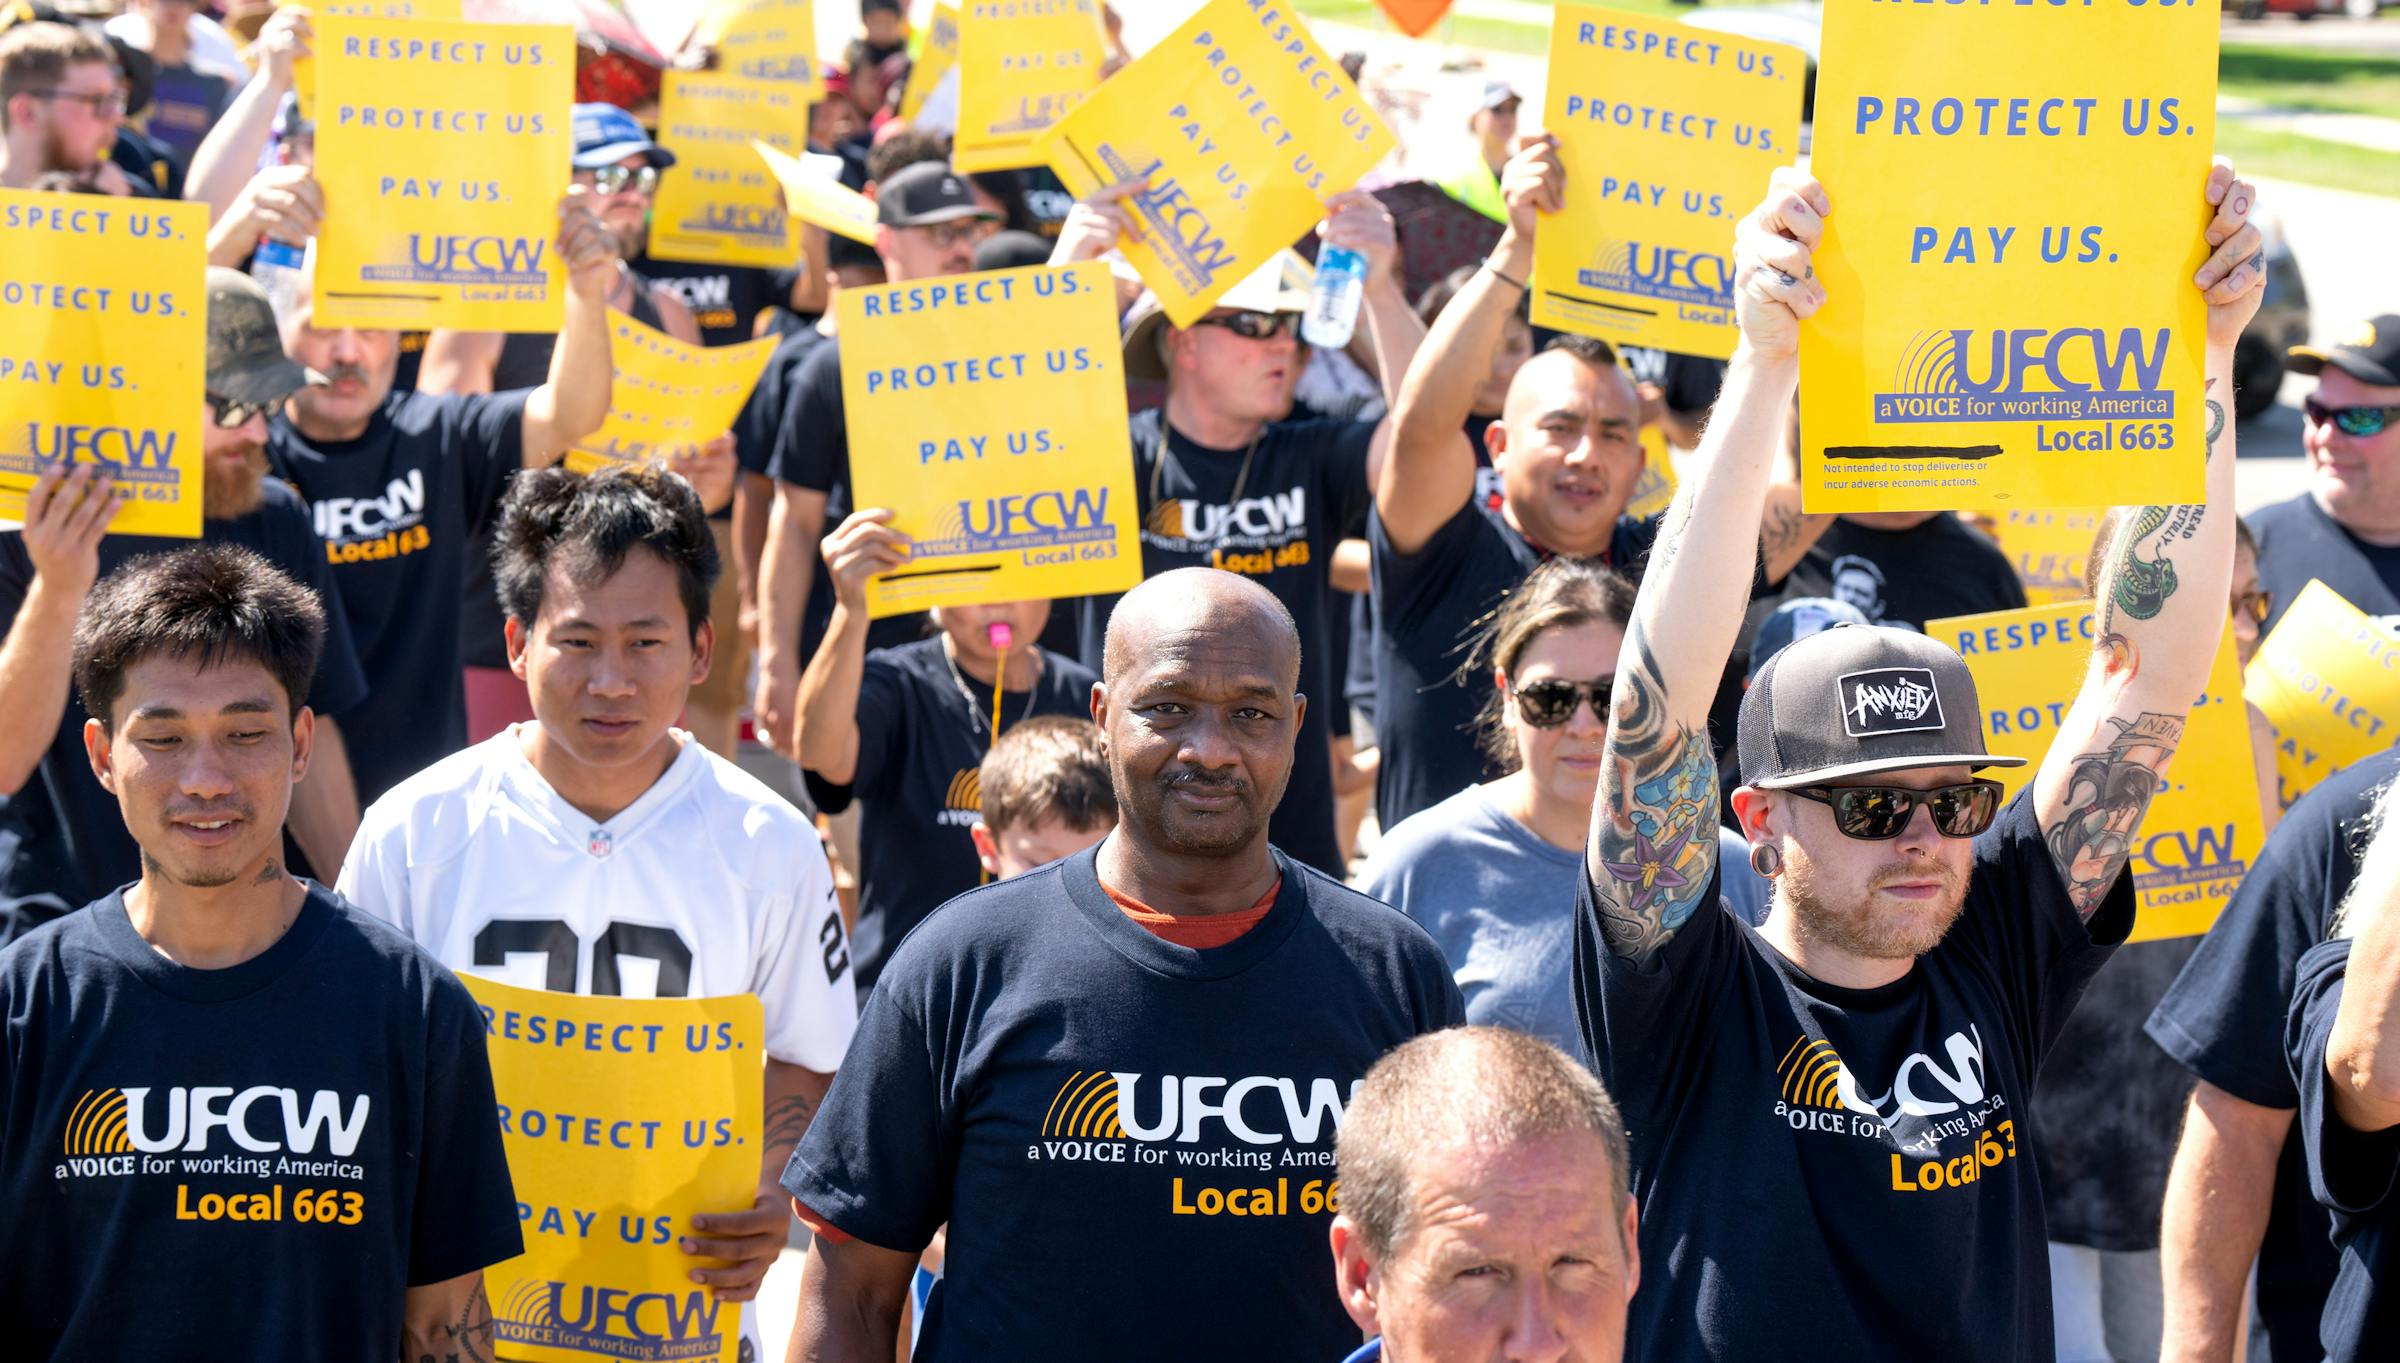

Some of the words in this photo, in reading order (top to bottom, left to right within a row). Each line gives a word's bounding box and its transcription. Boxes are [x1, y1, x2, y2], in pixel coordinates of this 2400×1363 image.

[345, 36, 487, 65] RESPECT
[504, 44, 556, 66] US.
[1578, 21, 1720, 66] RESPECT
[1737, 50, 1785, 80] US.
[1193, 30, 1293, 148] PROTECT
[339, 105, 489, 133] PROTECT
[1168, 104, 1218, 155] PAY
[1567, 95, 1718, 140] PROTECT
[1734, 124, 1782, 154] US.
[1855, 96, 2097, 136] PROTECT
[2121, 97, 2195, 136] US.
[380, 176, 443, 199] PAY
[460, 181, 513, 202] US.
[1601, 177, 1666, 207] PAY
[1683, 190, 1734, 220] US.
[6, 205, 111, 234] SPECT
[129, 215, 186, 240] US.
[409, 234, 545, 273] UFCW
[1910, 226, 2016, 264] PAY
[2040, 226, 2119, 264] US.
[3, 282, 112, 311] OTECT
[130, 291, 188, 317] US.
[864, 277, 1016, 317] RESPECT
[1034, 271, 1092, 297] US.
[1679, 304, 1728, 326] Local
[0, 358, 64, 384] PAY
[82, 364, 139, 391] US.
[866, 354, 1028, 394] PROTECT
[1046, 347, 1104, 374] US.
[1949, 327, 2171, 393] UFCW
[1880, 402, 1892, 417] a
[1894, 397, 1961, 417] VOICE
[1966, 396, 1996, 416] for
[2002, 396, 2082, 418] working
[2088, 395, 2168, 414] America
[28, 422, 177, 469] UFCW
[919, 435, 989, 465] PAY
[1007, 429, 1065, 456] US.
[2036, 422, 2113, 452] Local
[2119, 423, 2175, 451] 663
[1823, 464, 1841, 473] Not
[1844, 463, 1887, 473] intended
[1890, 464, 1900, 472] to
[1902, 463, 1924, 474] stop
[1926, 461, 1975, 473] deliveries
[1977, 463, 1987, 471] or
[1824, 479, 1849, 489] incur
[1851, 479, 1889, 489] adverse
[1891, 477, 1939, 488] economic
[313, 468, 425, 538] FCW
[957, 487, 1108, 539] UFCW
[2161, 505, 2192, 546] REFULLY
[326, 531, 398, 564] Local
[1023, 548, 1076, 567] Local
[1080, 544, 1118, 561] 663
[1958, 615, 2096, 655] RESPEC
[1848, 677, 1935, 728] ANXIETY
[1895, 709, 1916, 720] mfg
[2129, 823, 2234, 868] CW
[2145, 883, 2202, 907] Local
[2207, 878, 2241, 899] 66
[479, 1004, 663, 1053] RESPECT
[685, 1021, 744, 1053] US.
[120, 1085, 370, 1157] UFCW
[496, 1103, 661, 1149] ROTECT
[683, 1118, 744, 1148] US.
[1110, 1071, 1366, 1145] UFCW
[1774, 1099, 1788, 1117] a
[1787, 1109, 1845, 1134] OICE
[1851, 1114, 1888, 1139] for
[1901, 1116, 1970, 1153] orking
[55, 1163, 69, 1180] a
[68, 1155, 135, 1178] VOICE
[142, 1154, 175, 1175] for
[182, 1155, 271, 1178] working
[275, 1156, 364, 1180] America
[1027, 1145, 1040, 1161] a
[1043, 1141, 1126, 1163] VOICE
[1134, 1143, 1169, 1165] for
[1176, 1146, 1272, 1171] working
[1890, 1139, 1980, 1192] Local
[1979, 1119, 2017, 1167] 63
[176, 1184, 282, 1222] Local
[293, 1188, 365, 1225] 663
[1172, 1177, 1287, 1216] Local
[1300, 1178, 1342, 1214] 66
[516, 1202, 597, 1239] PAY
[619, 1215, 687, 1245] US.
[547, 1281, 722, 1342] UFCW
[498, 1322, 553, 1344] VOICE
[558, 1331, 582, 1346] for
[587, 1335, 655, 1361] working
[660, 1338, 719, 1359] America
